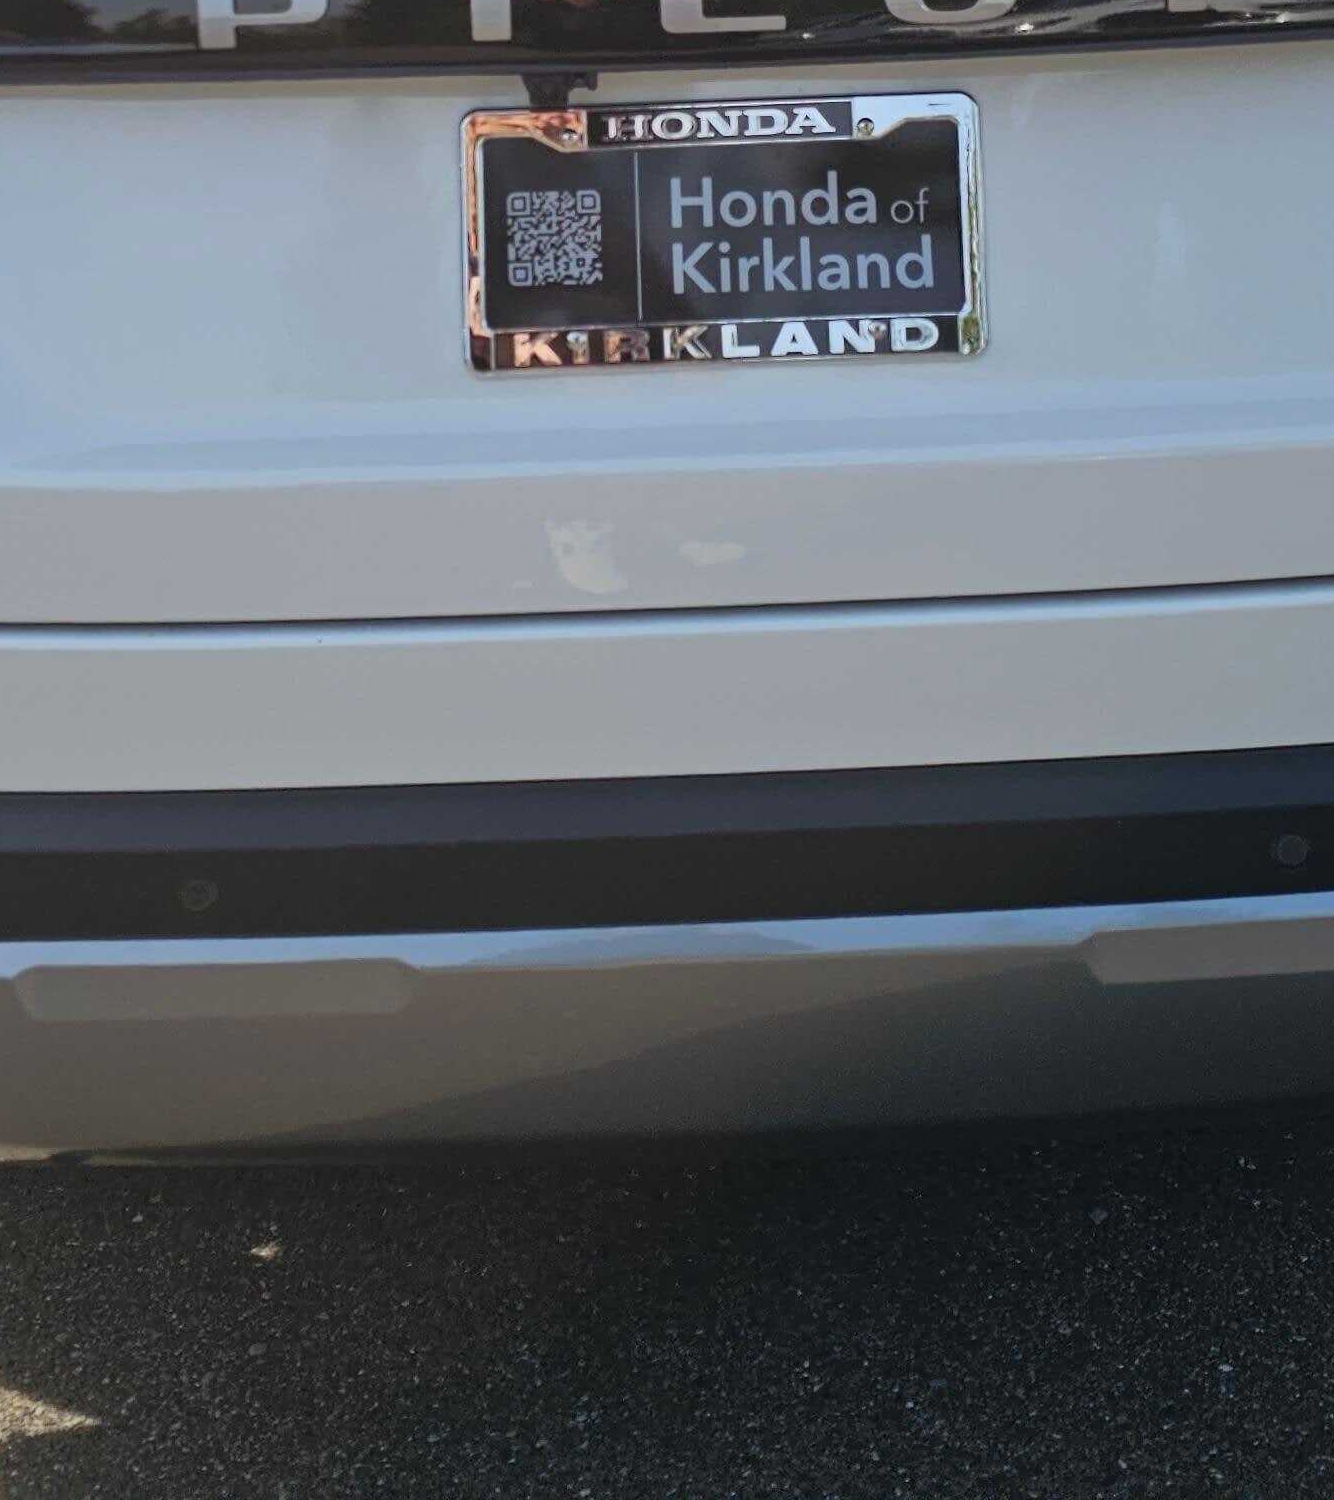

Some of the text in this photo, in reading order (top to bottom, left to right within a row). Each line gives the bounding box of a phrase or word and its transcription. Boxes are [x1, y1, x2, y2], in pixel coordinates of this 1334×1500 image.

[602, 107, 837, 141] HONDA
[670, 171, 930, 229] Honda of
[671, 234, 935, 295] Kirkland
[512, 318, 940, 368] KIRKLAND
